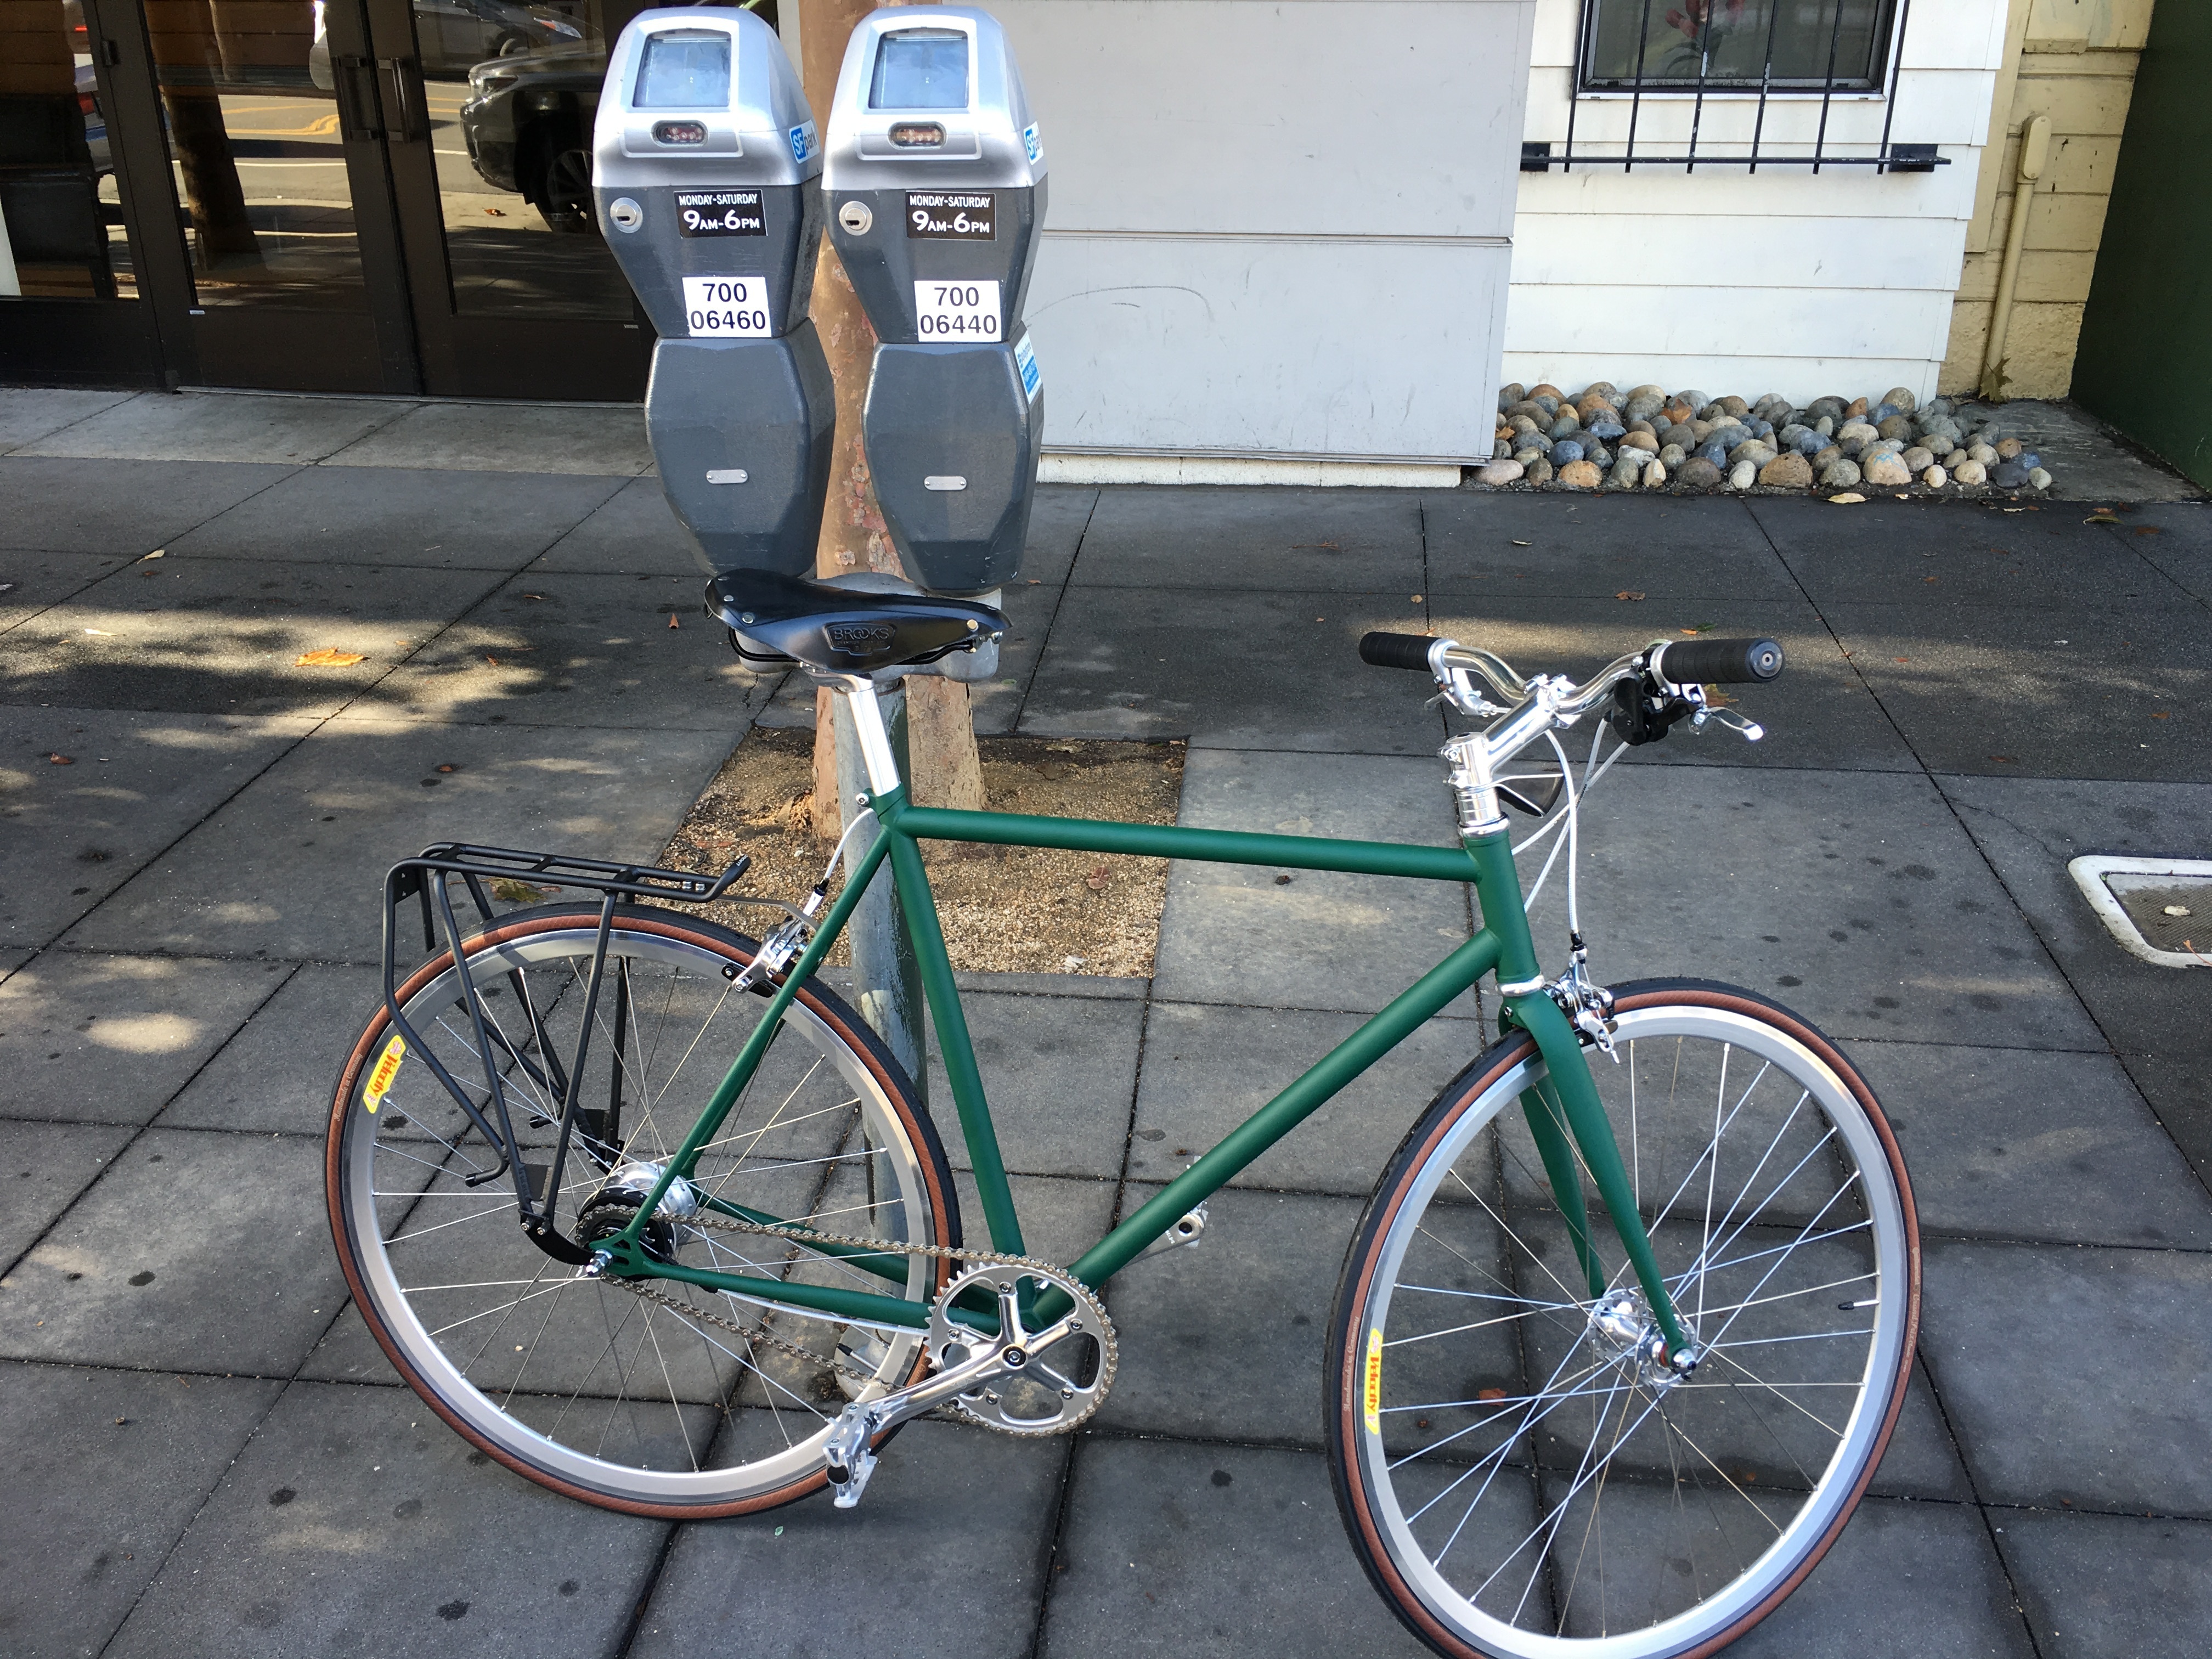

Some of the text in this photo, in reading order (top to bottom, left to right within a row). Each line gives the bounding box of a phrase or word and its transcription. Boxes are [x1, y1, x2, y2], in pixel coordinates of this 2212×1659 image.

[678, 193, 758, 206] MONDAY-SATURDAY
[910, 195, 991, 208] MONDAY-SATURDAY
[683, 209, 760, 230] 9AM-6PM
[912, 210, 990, 233] 9AM-6PM
[702, 283, 747, 302] 700
[934, 287, 979, 306] 700
[691, 310, 766, 330] 06460
[920, 314, 997, 334] 06440
[833, 628, 889, 640] BROOKS
[369, 1054, 398, 1096] Velocity
[1367, 1356, 1379, 1412] Velocity
